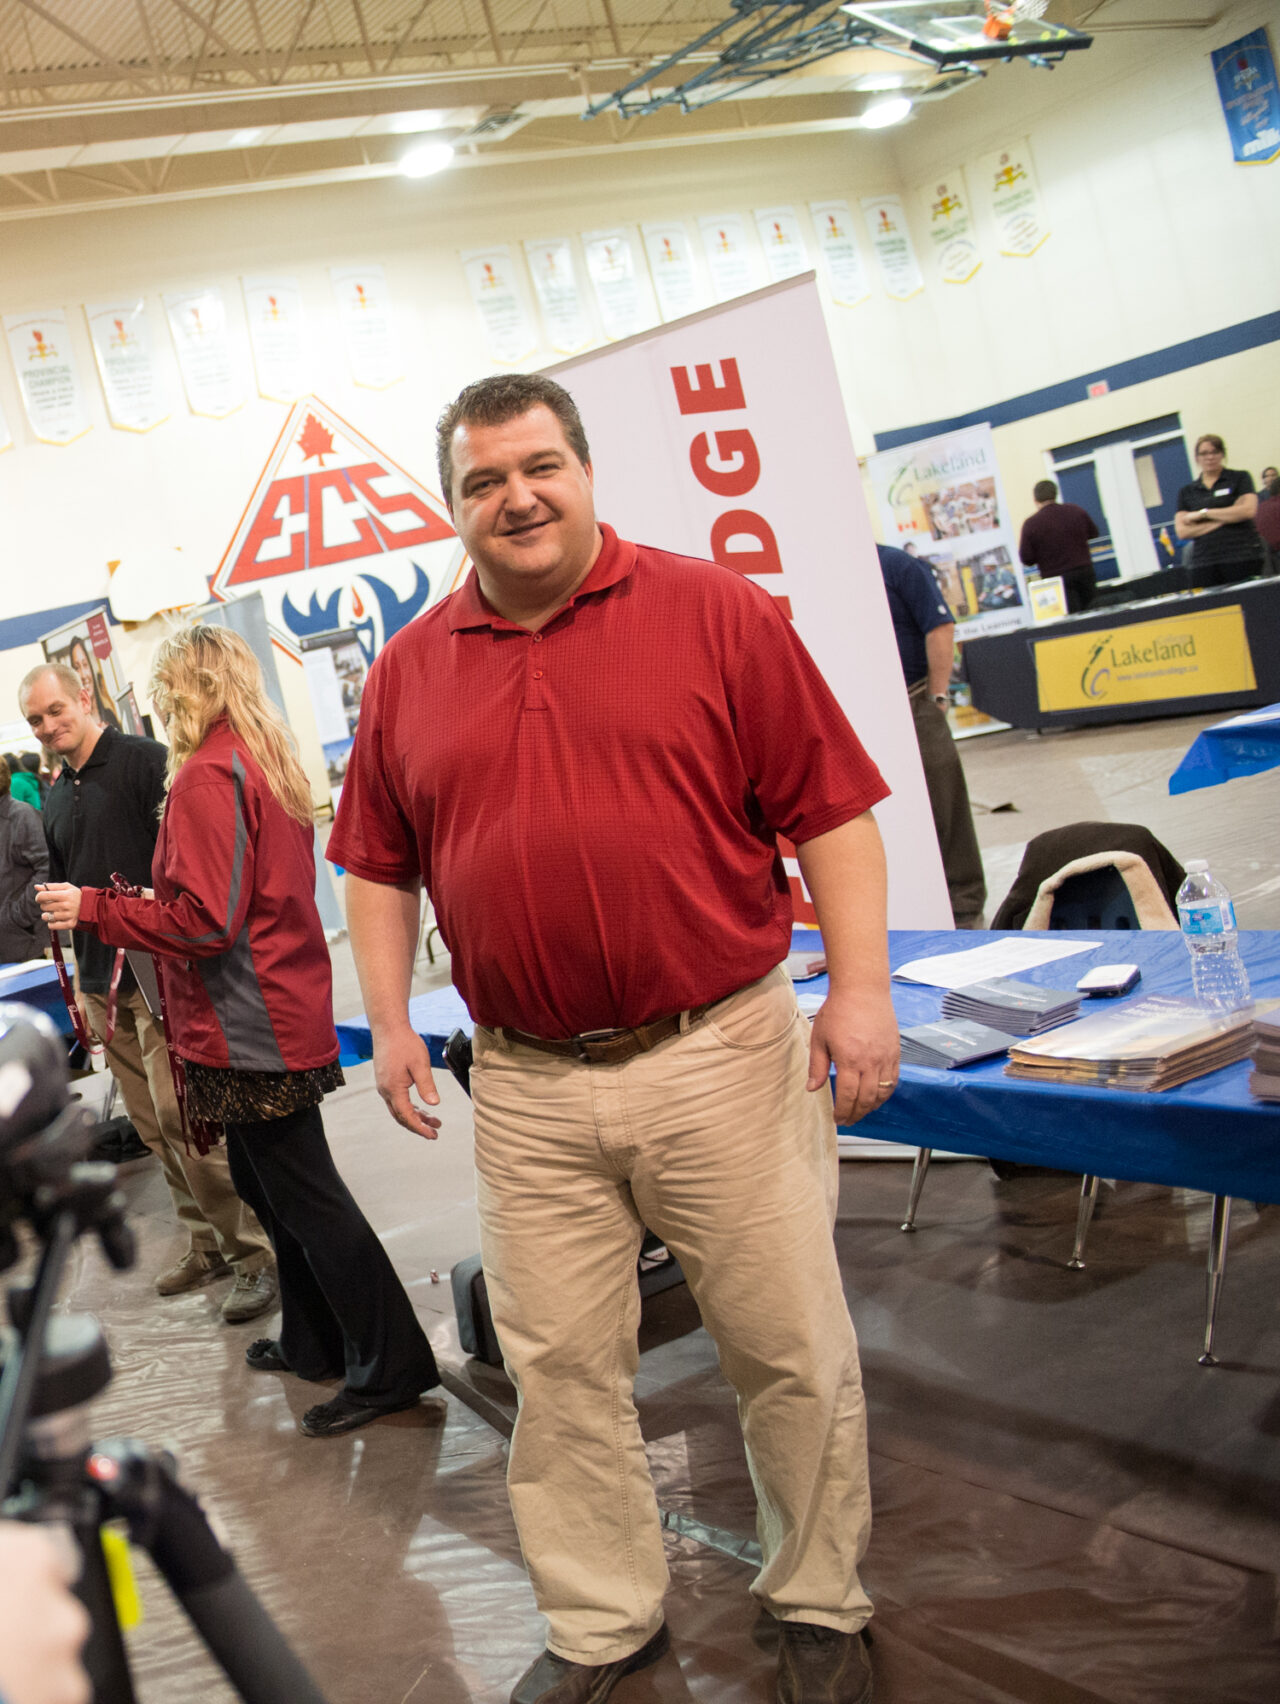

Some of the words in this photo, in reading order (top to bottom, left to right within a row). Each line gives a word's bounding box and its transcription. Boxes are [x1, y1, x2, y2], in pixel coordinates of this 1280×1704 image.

[913, 447, 988, 482] Lakeland
[670, 357, 794, 621] DGE
[1110, 634, 1197, 668] Lakeland
